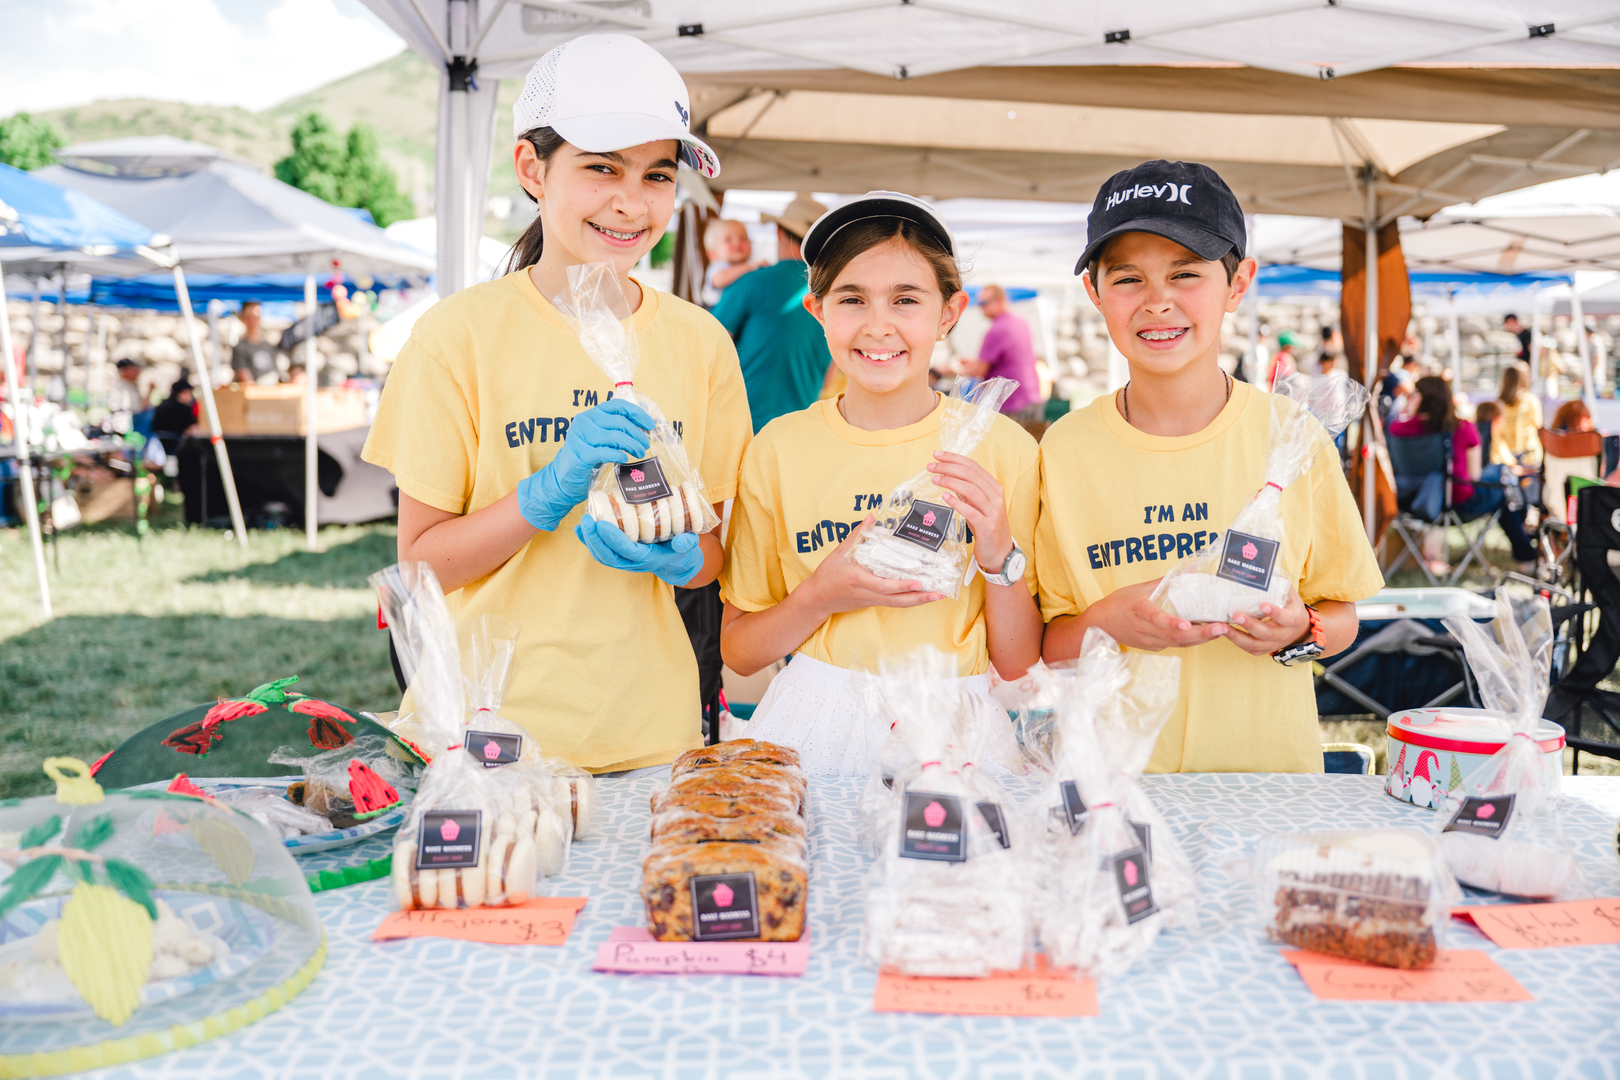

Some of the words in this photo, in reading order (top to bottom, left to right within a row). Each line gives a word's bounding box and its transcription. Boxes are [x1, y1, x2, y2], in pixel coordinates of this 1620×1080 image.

[1105, 183, 1168, 212] Hurley
[572, 389, 599, 407] I'M
[853, 493, 883, 512] I'M
[1144, 504, 1175, 524] I'M
[1182, 502, 1208, 522] AN
[906, 523, 918, 531] BAKE
[919, 527, 940, 539] MADNESS
[1227, 557, 1241, 566] BAKE
[1241, 562, 1266, 574] MADNESS
[517, 920, 566, 941] $3
[613, 943, 720, 965] Pumpkin
[745, 947, 788, 970] $4
